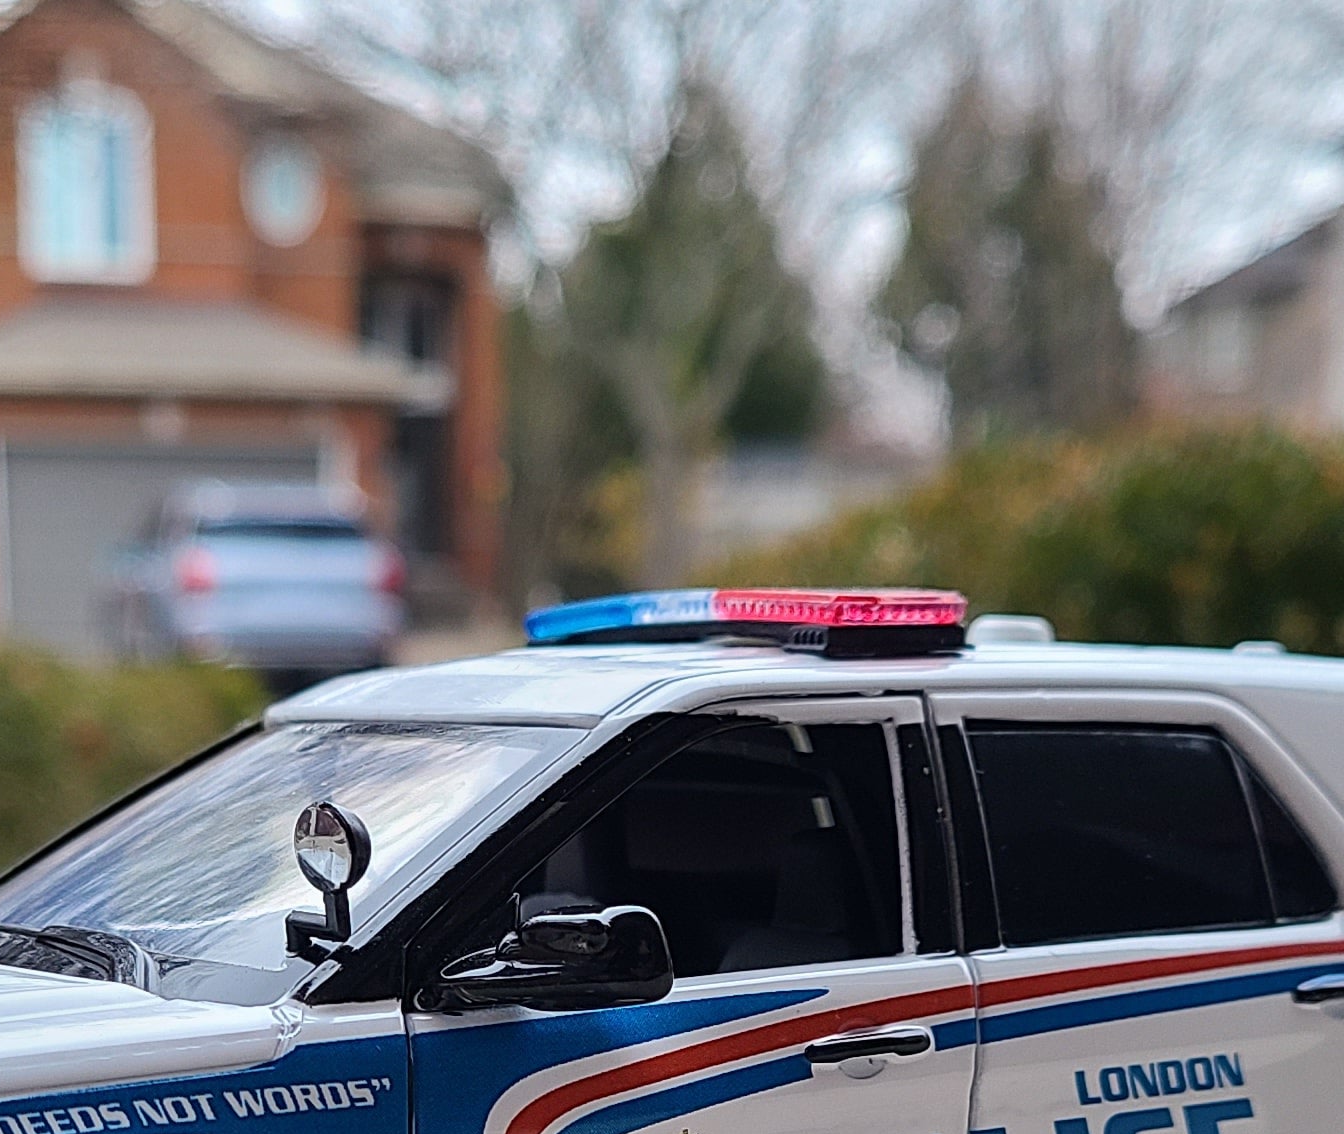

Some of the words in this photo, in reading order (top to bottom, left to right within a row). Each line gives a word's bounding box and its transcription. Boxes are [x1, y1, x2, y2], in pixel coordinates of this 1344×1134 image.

[132, 1093, 225, 1127] NOT
[222, 1077, 393, 1118] WORDS”
[1073, 1052, 1244, 1105] LONDON
